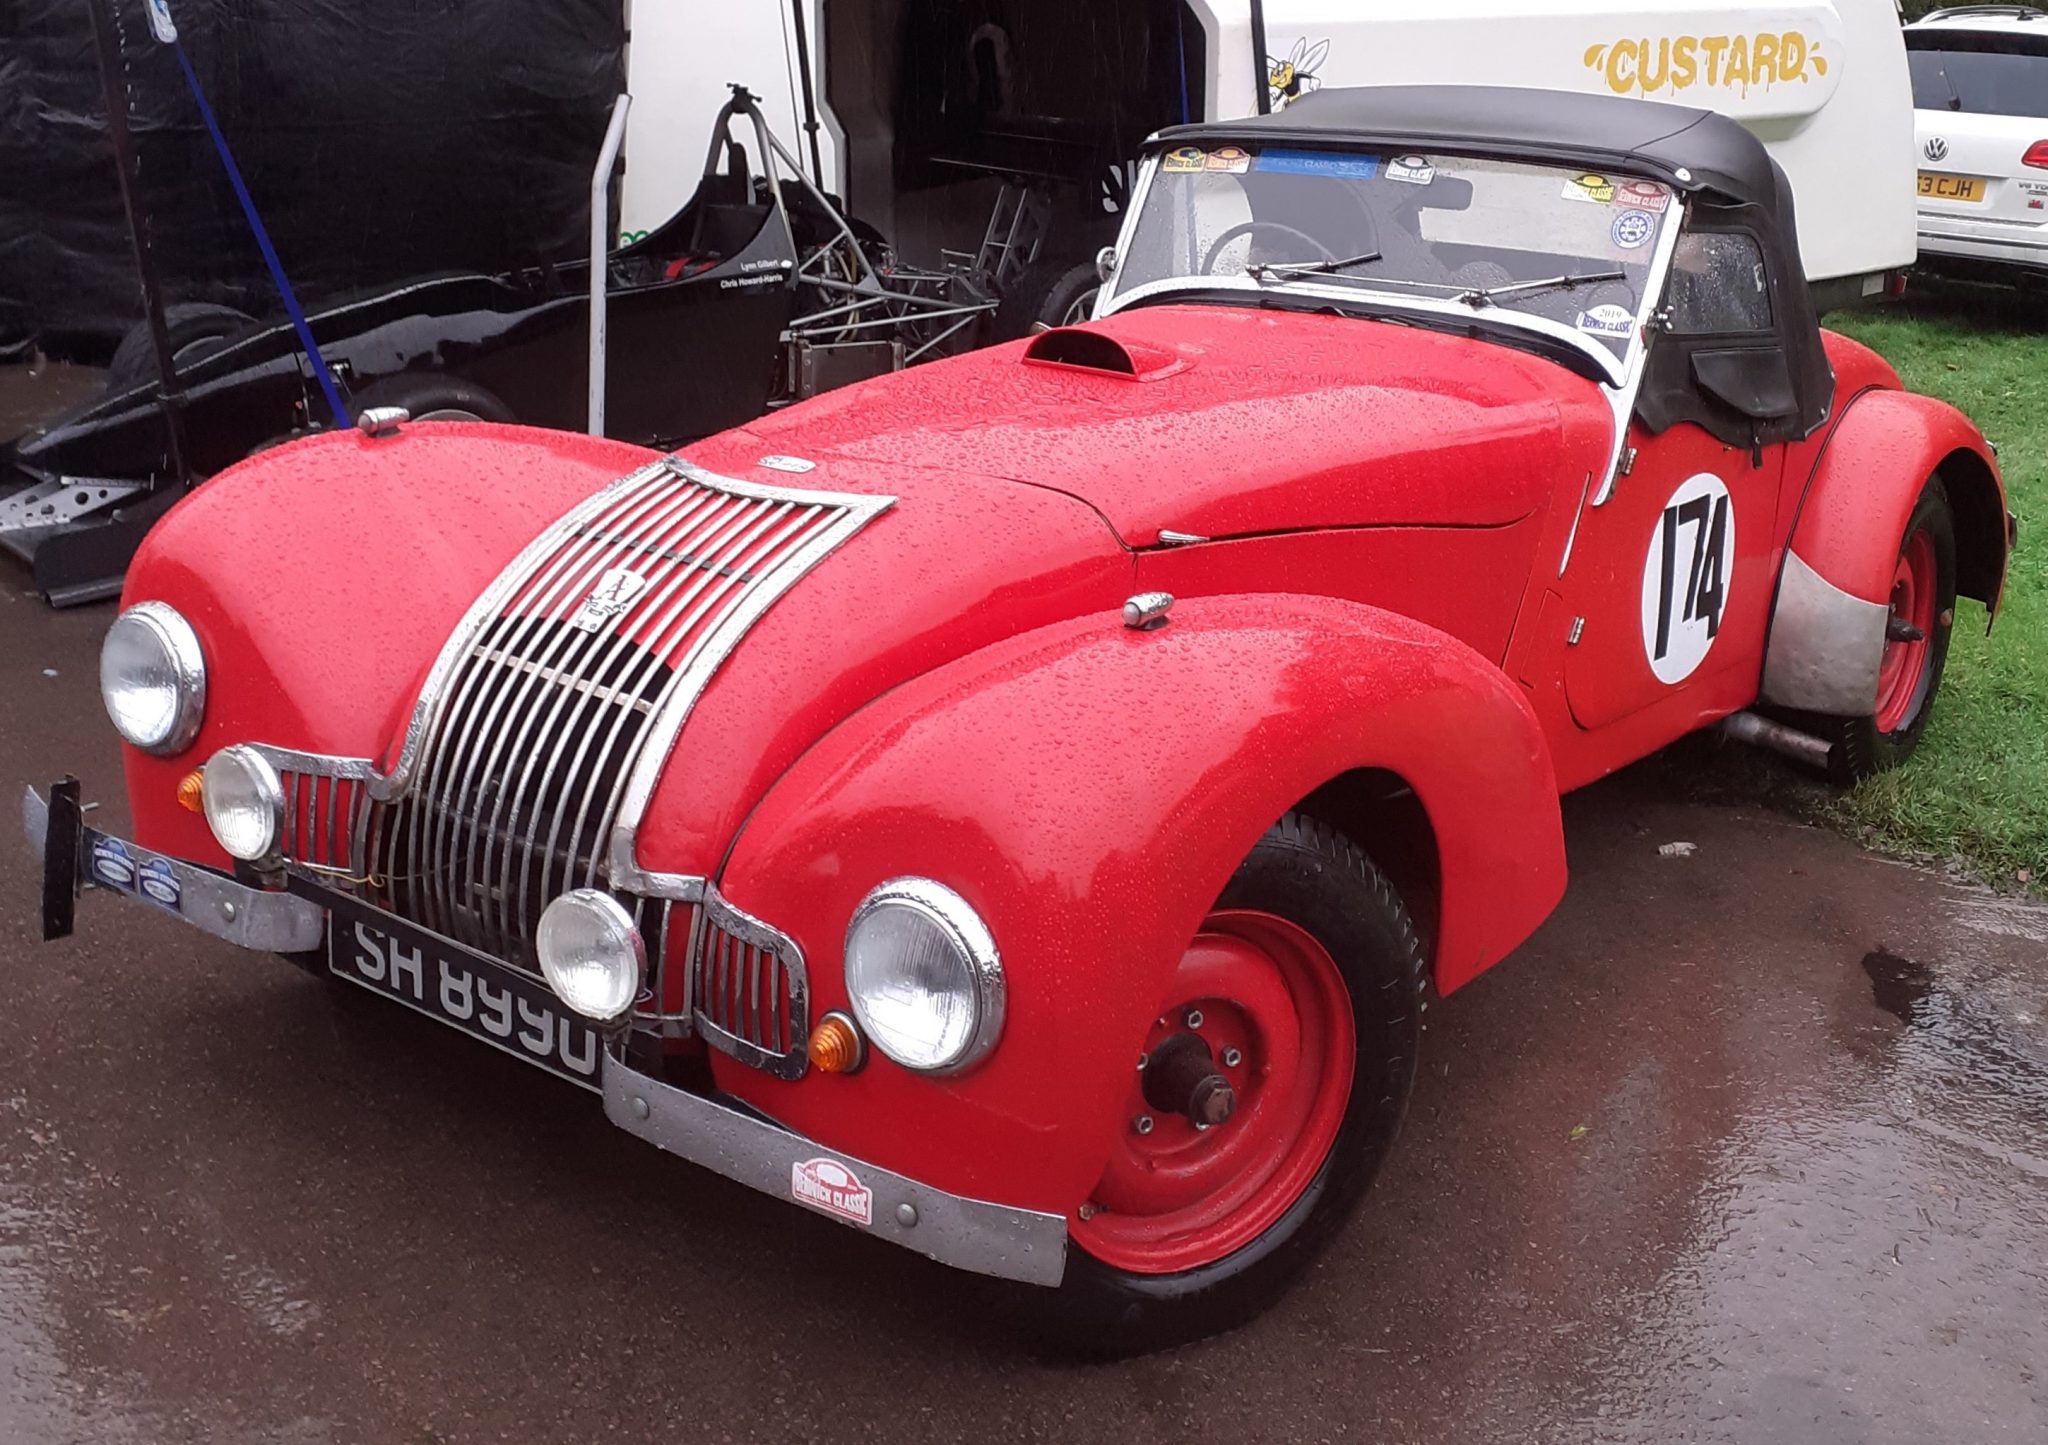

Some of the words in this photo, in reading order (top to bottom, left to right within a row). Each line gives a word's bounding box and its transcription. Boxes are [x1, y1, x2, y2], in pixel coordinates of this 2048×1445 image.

[1605, 31, 1808, 97] CUSTARD
[1936, 178, 1973, 197] CJH
[720, 279, 738, 289] Chris
[741, 261, 757, 272] Lynn
[757, 259, 779, 268] Gilbert
[1654, 494, 1729, 661] 174
[355, 921, 423, 1000] SH
